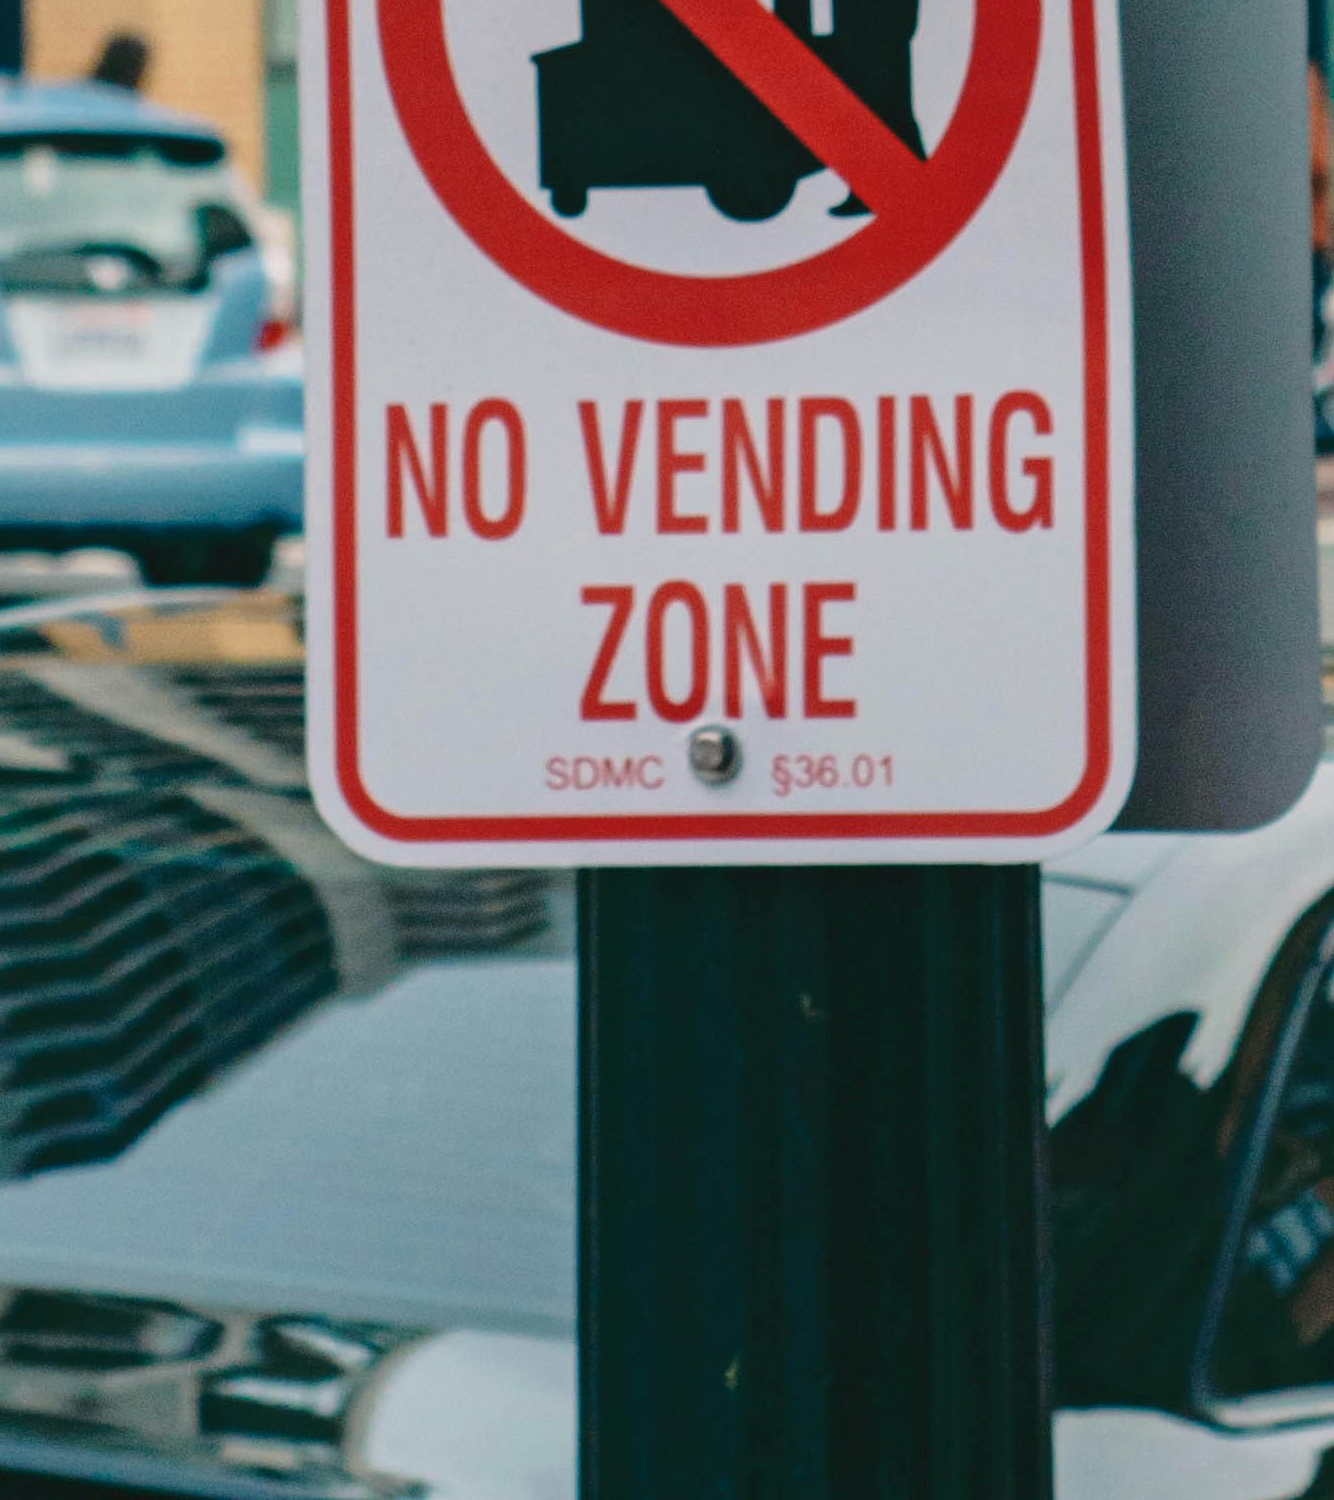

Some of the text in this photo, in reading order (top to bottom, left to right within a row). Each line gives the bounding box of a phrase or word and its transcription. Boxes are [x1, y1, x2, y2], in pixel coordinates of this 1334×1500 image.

[385, 389, 1055, 540] NO VENDING
[579, 580, 857, 723] ZONE
[544, 754, 895, 797] SDMC §36.01
